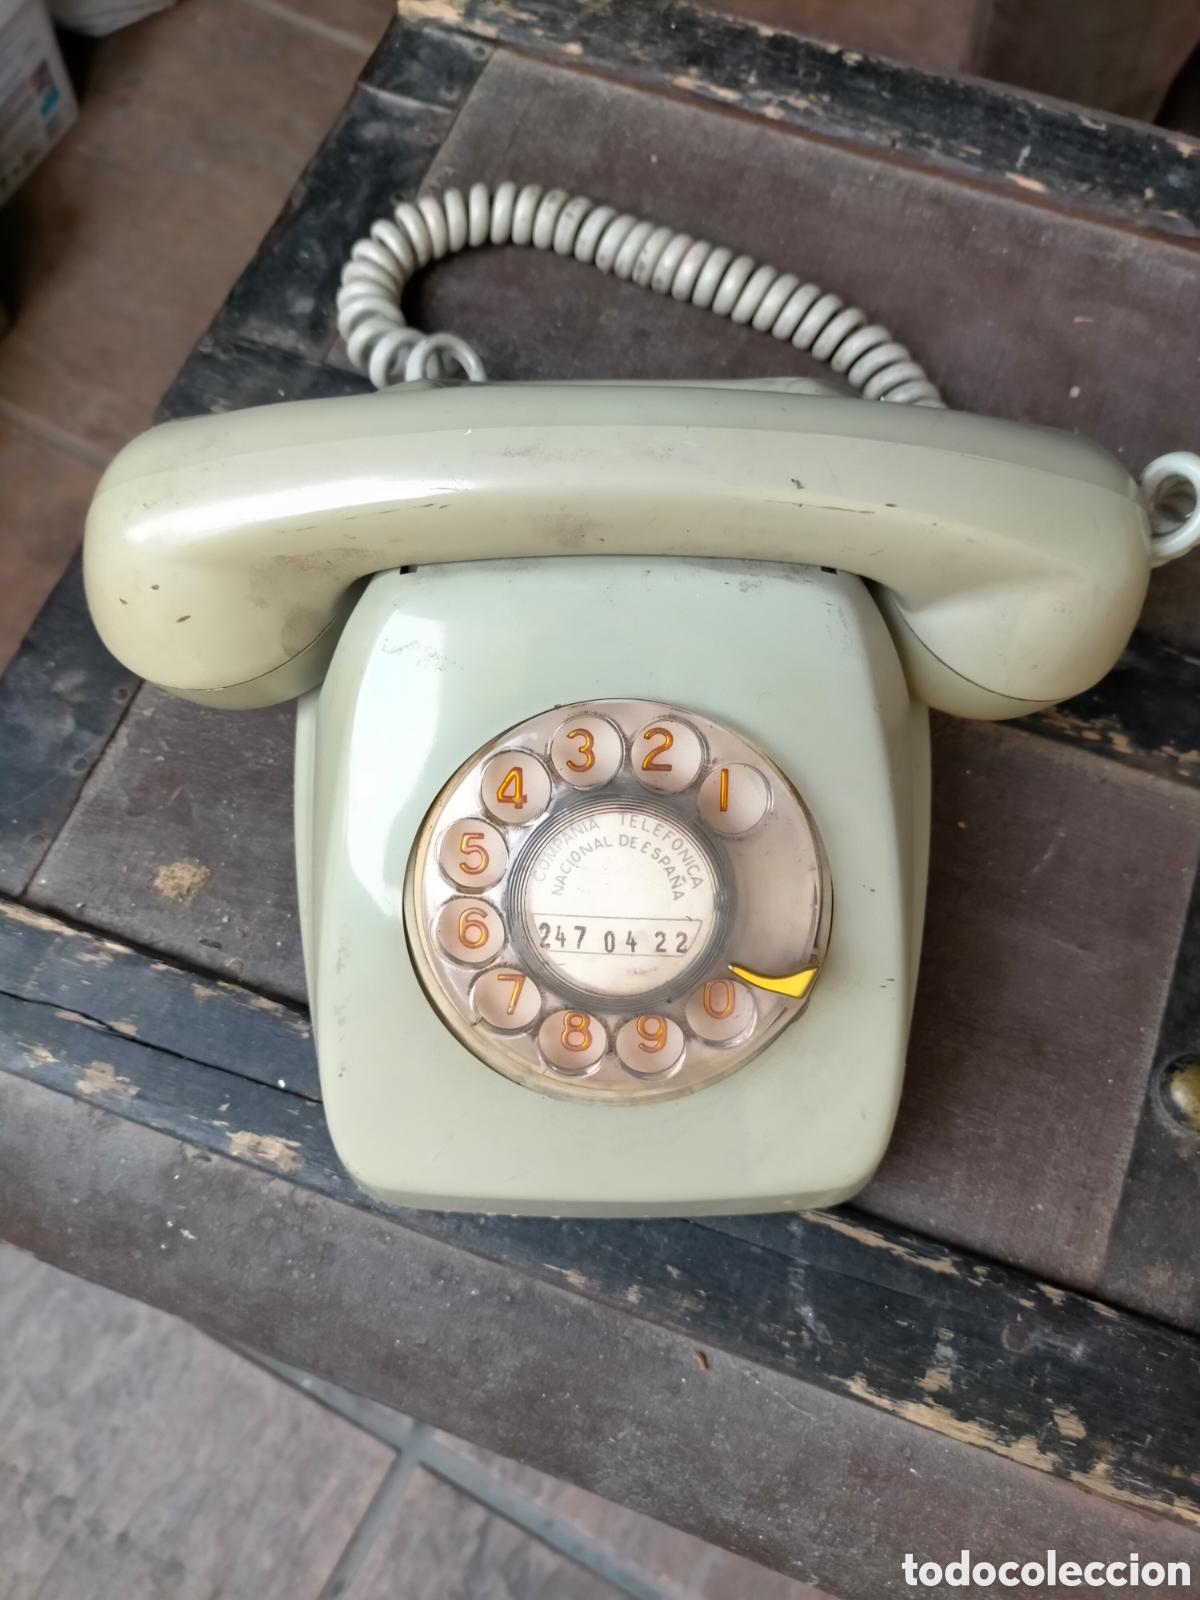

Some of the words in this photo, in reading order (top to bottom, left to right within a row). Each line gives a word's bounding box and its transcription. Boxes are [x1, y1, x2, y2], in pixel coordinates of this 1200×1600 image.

[566, 728, 595, 772] 3
[641, 727, 674, 771] 2
[496, 767, 527, 809] 4
[719, 768, 729, 812] 1
[459, 832, 489, 875] 5
[551, 836, 613, 896] NACIONAL
[619, 834, 639, 849] DE
[640, 842, 685, 901] ESPAÑA
[458, 907, 488, 949] 6
[497, 974, 526, 1015] 7
[703, 979, 734, 1019] 0
[561, 1010, 592, 1052] 8
[636, 1014, 668, 1053] 9
